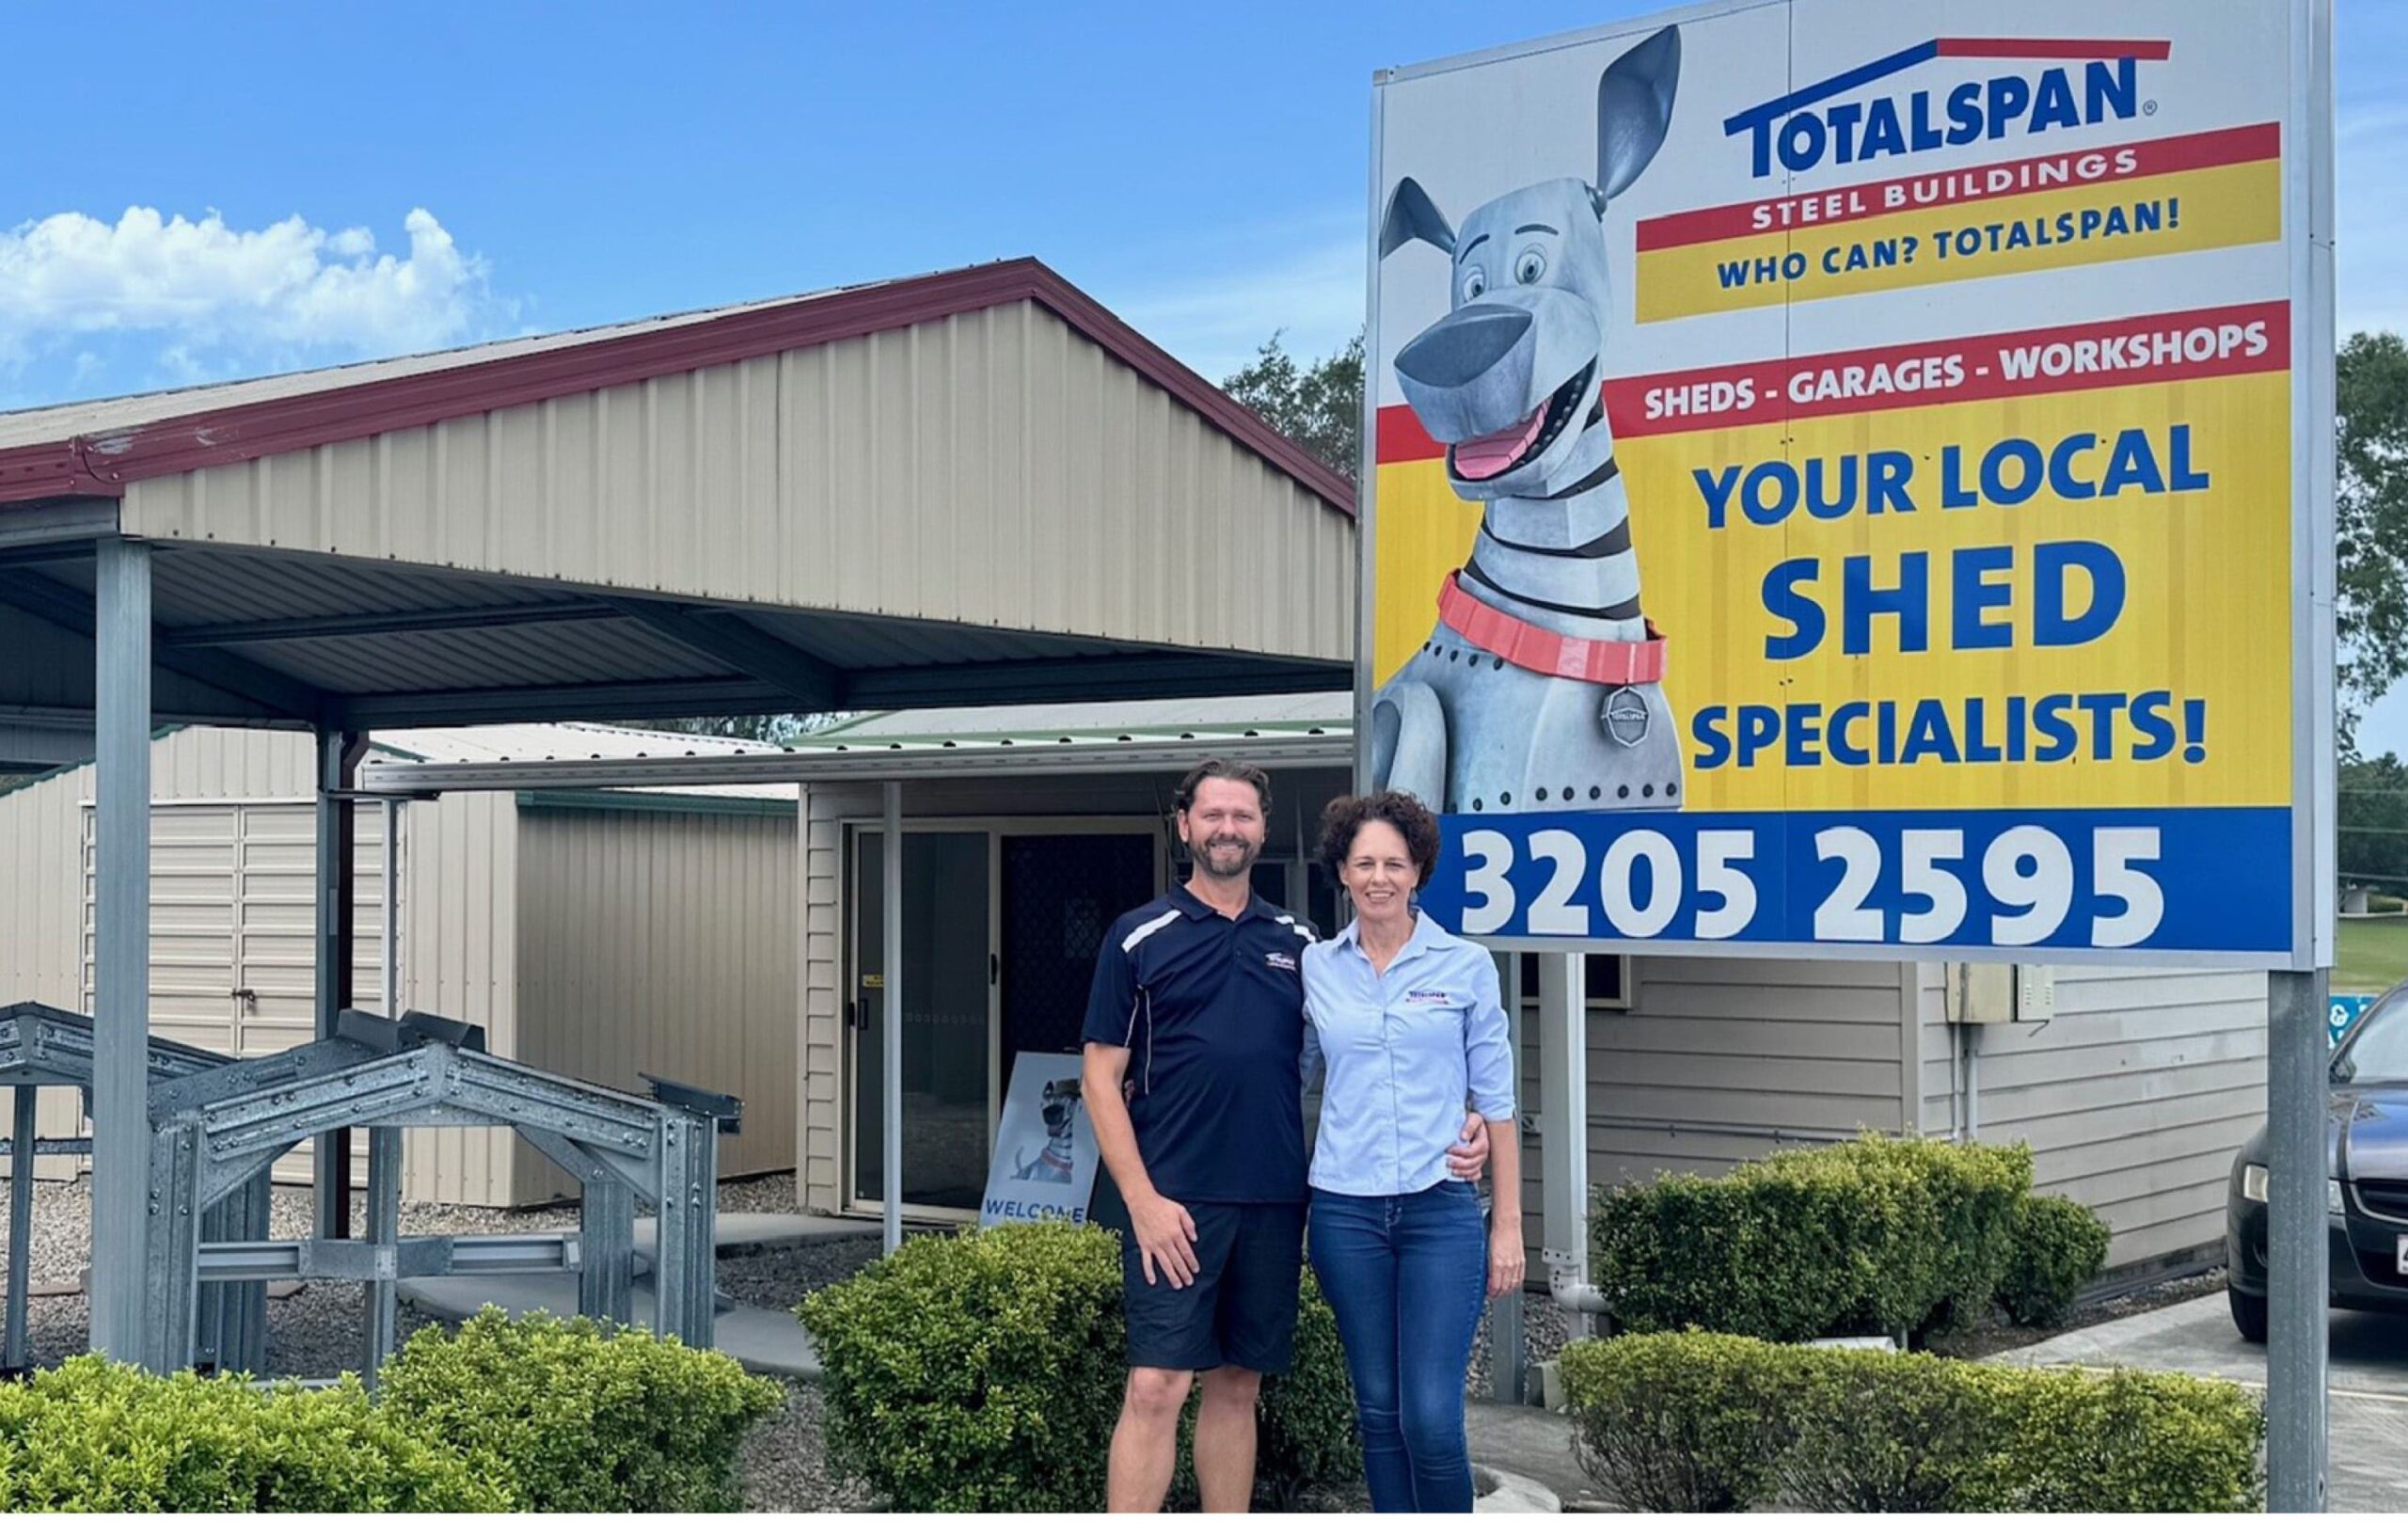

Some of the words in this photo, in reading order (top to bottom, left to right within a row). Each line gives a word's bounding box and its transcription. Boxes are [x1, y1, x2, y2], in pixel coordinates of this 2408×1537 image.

[1723, 55, 2136, 179] TOTALSPAN
[1751, 190, 1866, 230] STEEL
[1883, 150, 2138, 209] BUILDINGS
[1718, 253, 1807, 288] WHO
[1822, 236, 1918, 274] CAN?
[1934, 198, 2179, 259] TOTALSPAN!
[1644, 378, 1755, 420] SHEDS
[1787, 354, 1965, 404] GARAGES
[1999, 321, 2268, 381] WORKSHOPS
[1694, 451, 1915, 528] YOUR
[1941, 425, 2210, 509] LOCAL
[1762, 541, 2126, 660] SHED
[1692, 690, 2206, 768] SPECIALISTS!
[1462, 830, 1757, 939] 3205
[1812, 825, 2164, 948] 2595
